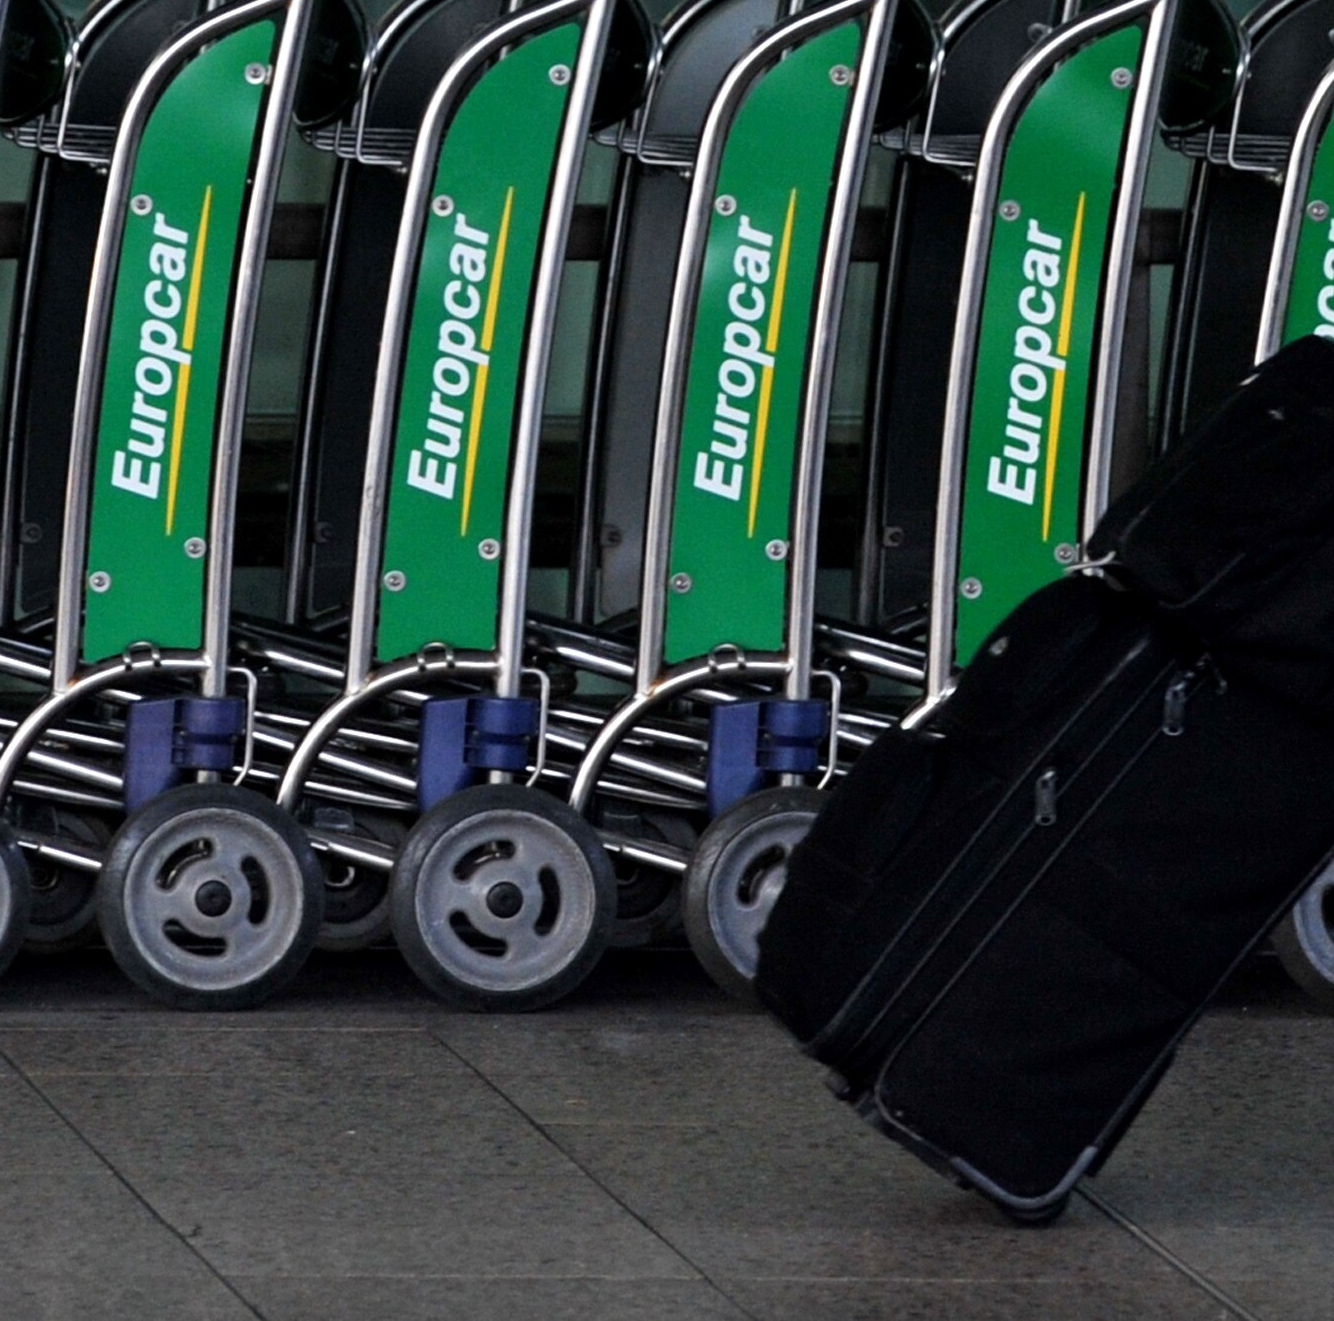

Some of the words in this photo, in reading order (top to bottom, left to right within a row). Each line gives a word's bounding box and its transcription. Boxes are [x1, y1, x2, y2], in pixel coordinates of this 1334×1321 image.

[112, 212, 193, 499] Europcar
[408, 212, 491, 500] Europcar
[694, 214, 776, 502] Europcar
[988, 218, 1067, 505] Europcar
